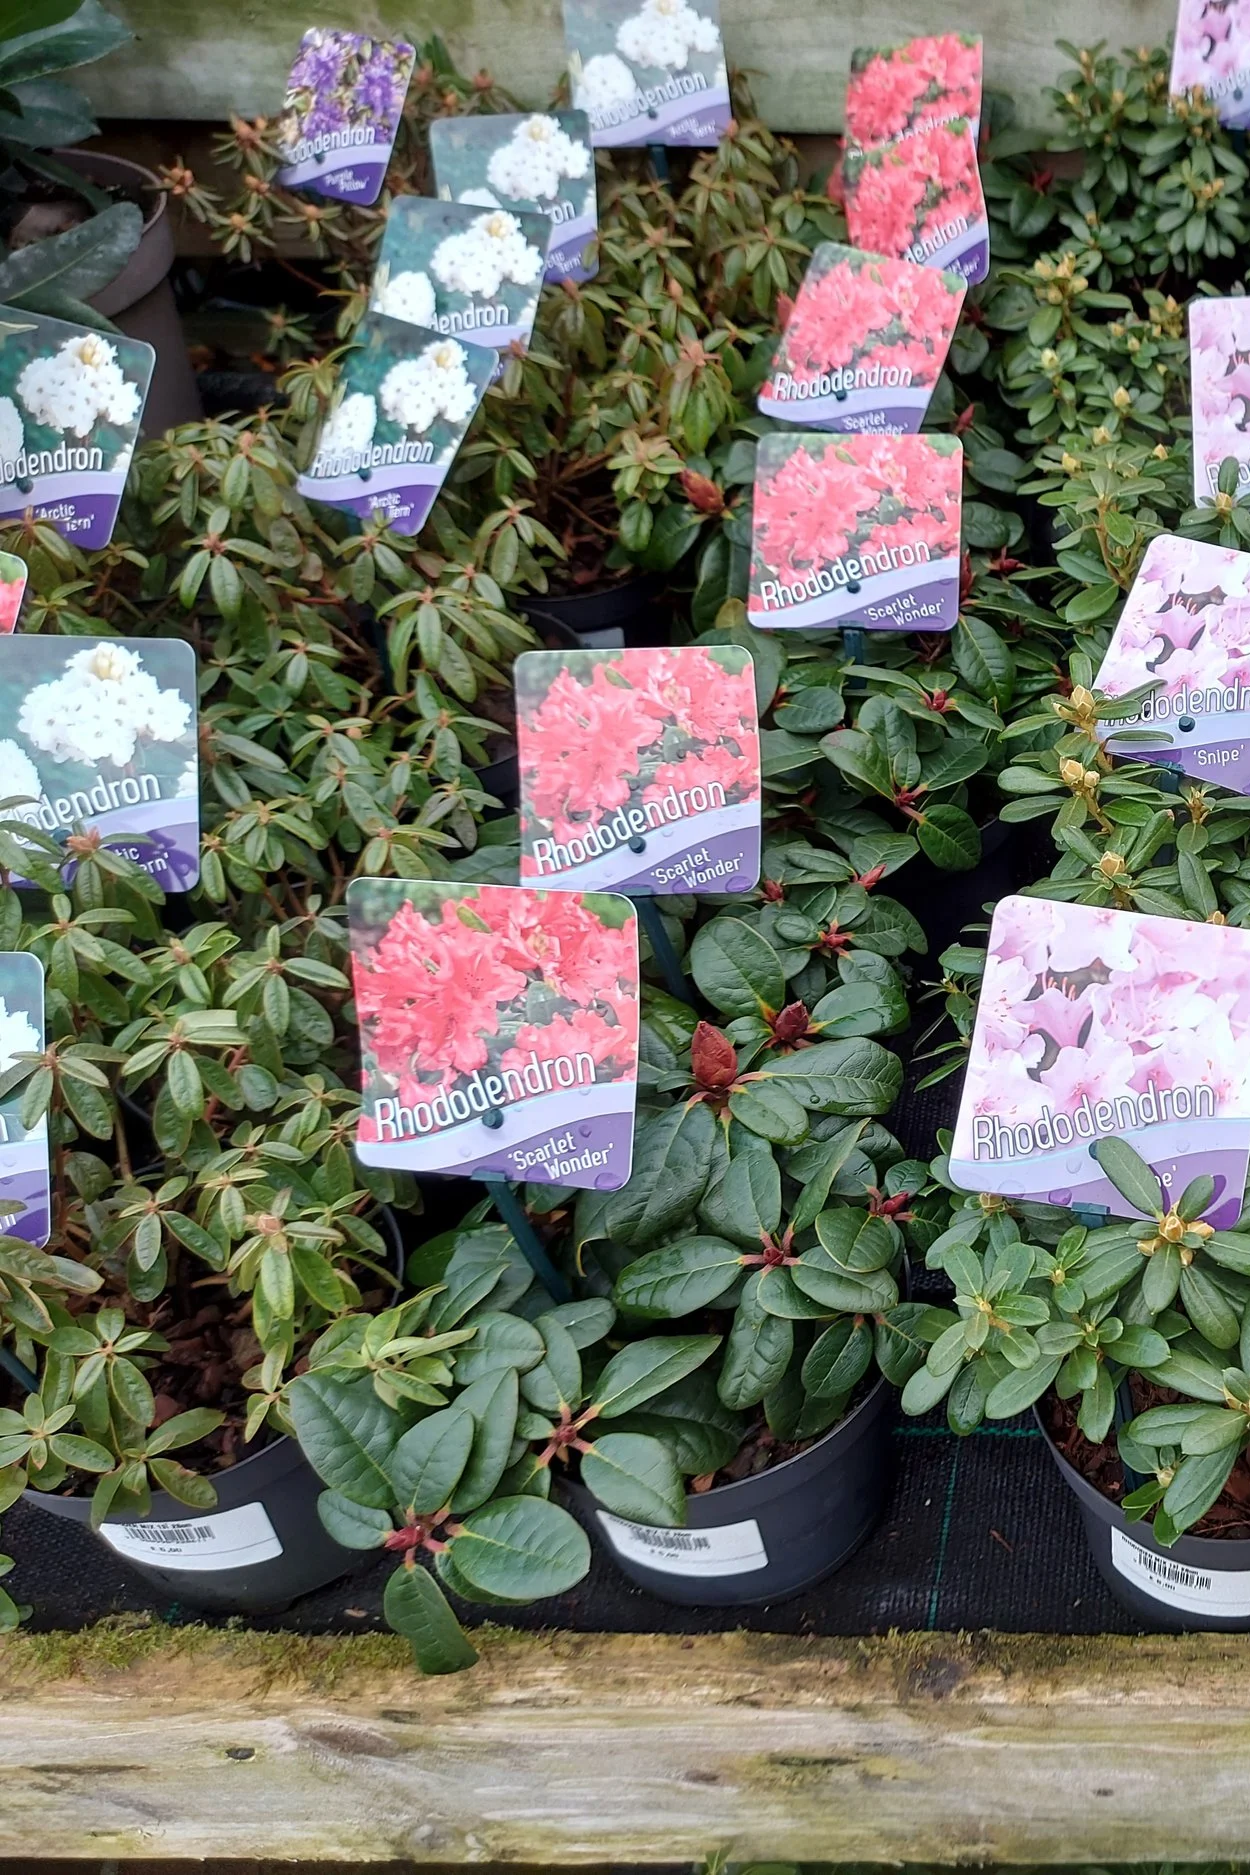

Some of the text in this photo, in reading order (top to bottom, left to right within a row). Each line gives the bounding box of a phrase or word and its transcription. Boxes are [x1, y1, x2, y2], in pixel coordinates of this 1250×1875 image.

[903, 214, 969, 264] dendron
[428, 303, 509, 335] dendron
[772, 361, 913, 401] Rhododendron
[842, 411, 886, 431] 'Scarlet
[309, 434, 435, 478] Rhododendron
[35, 504, 76, 519] 'Arctic
[760, 540, 931, 611] Rhododendron
[863, 593, 917, 622] 'Scarlet
[892, 597, 945, 626] Wonder'
[1193, 744, 1245, 767] 'Snipe'
[532, 780, 728, 876] Rhododendron
[650, 847, 711, 885] 'Scarlet
[682, 852, 744, 889] Wonder'
[375, 1050, 597, 1142] Rhododendron
[972, 1078, 1216, 1161] Rhododendron
[507, 1131, 577, 1170] 'Scarlet
[543, 1142, 614, 1180] Wonder'
